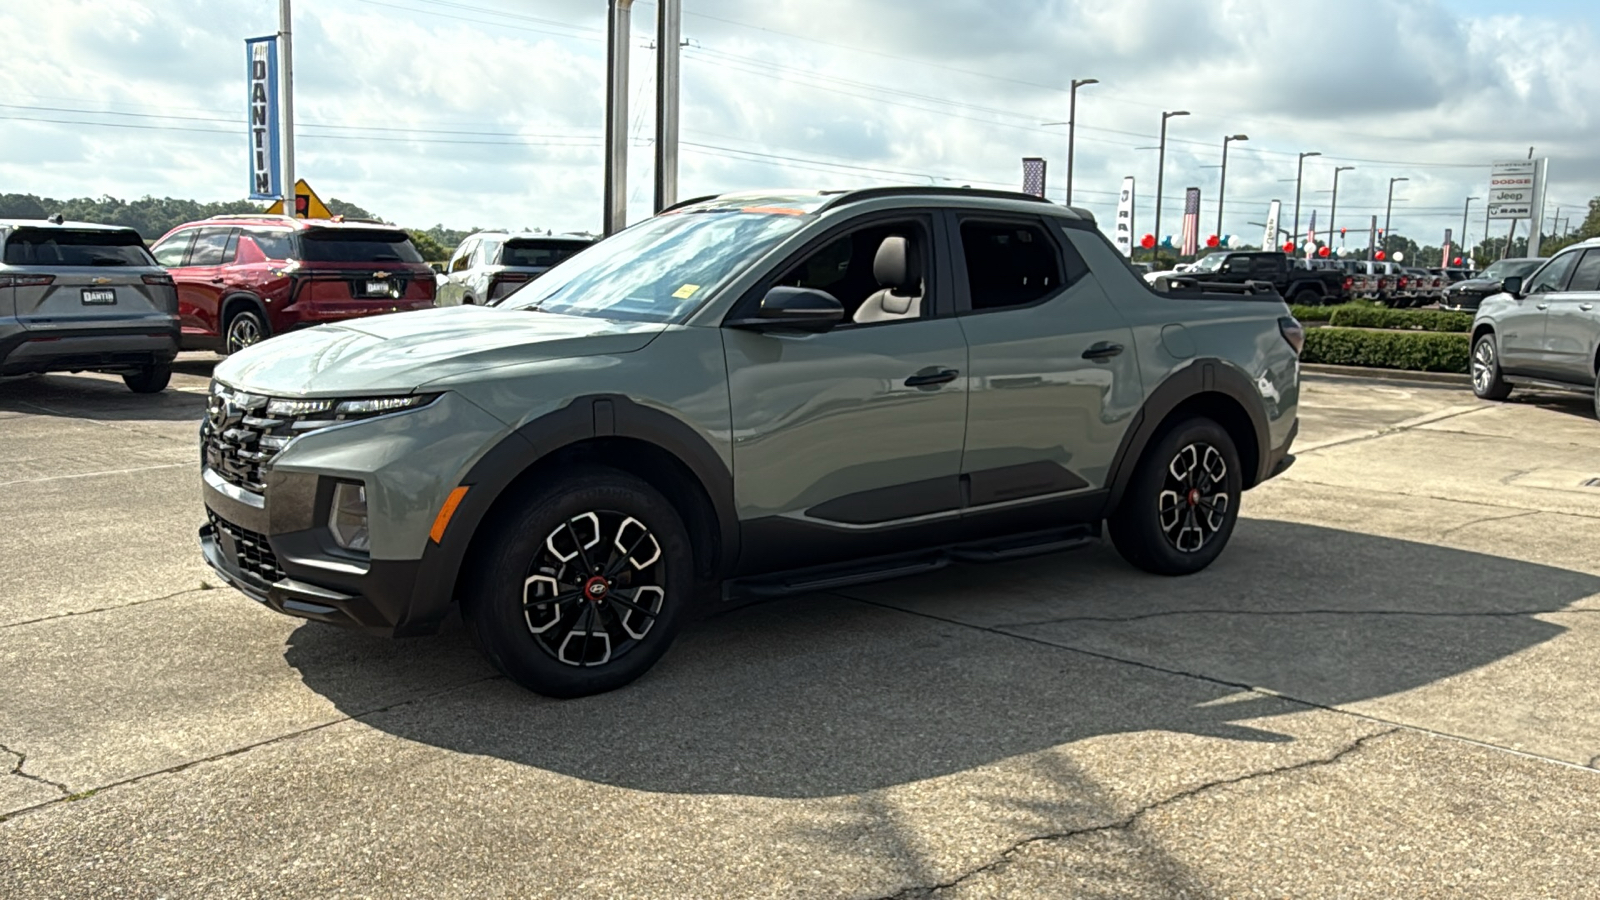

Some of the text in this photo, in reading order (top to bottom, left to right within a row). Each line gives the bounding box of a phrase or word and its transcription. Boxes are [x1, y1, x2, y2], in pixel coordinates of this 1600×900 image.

[252, 60, 269, 193] DANTIN
[1496, 191, 1523, 201] Jeep
[1117, 210, 1129, 244] RAM
[83, 291, 114, 303] DANTIN
